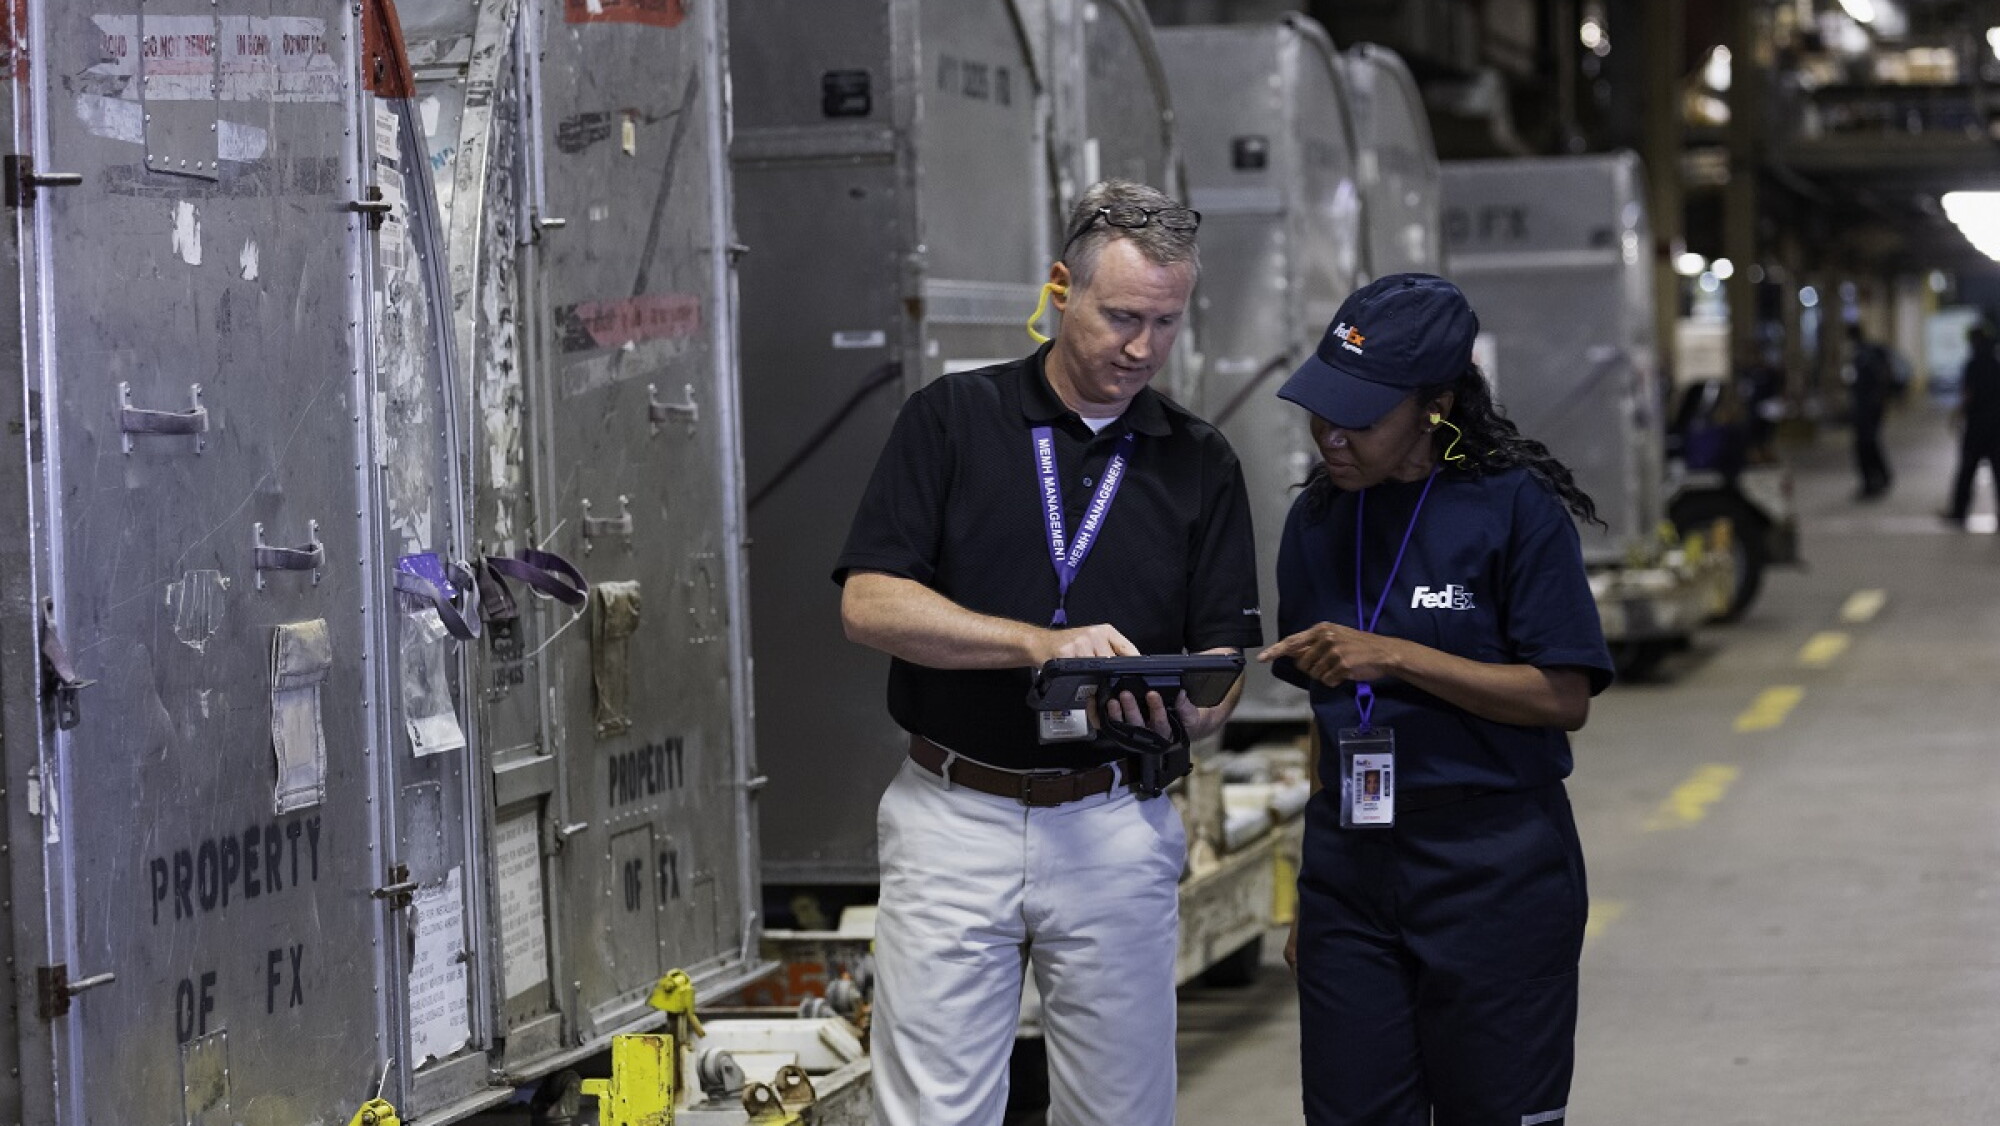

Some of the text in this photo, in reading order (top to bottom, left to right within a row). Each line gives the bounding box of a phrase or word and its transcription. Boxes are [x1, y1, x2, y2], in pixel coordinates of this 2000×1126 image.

[1333, 322, 1366, 347] FedEx
[1038, 438, 1066, 562] MEMH MANAGEMENT
[1067, 453, 1125, 568] MEMH MANAGEMENT
[1411, 583, 1476, 611] FedEx
[610, 736, 684, 808] PROPERTY
[150, 815, 321, 925] PROPERTY
[624, 851, 681, 912] OF FX
[176, 943, 304, 1045] OF FX
